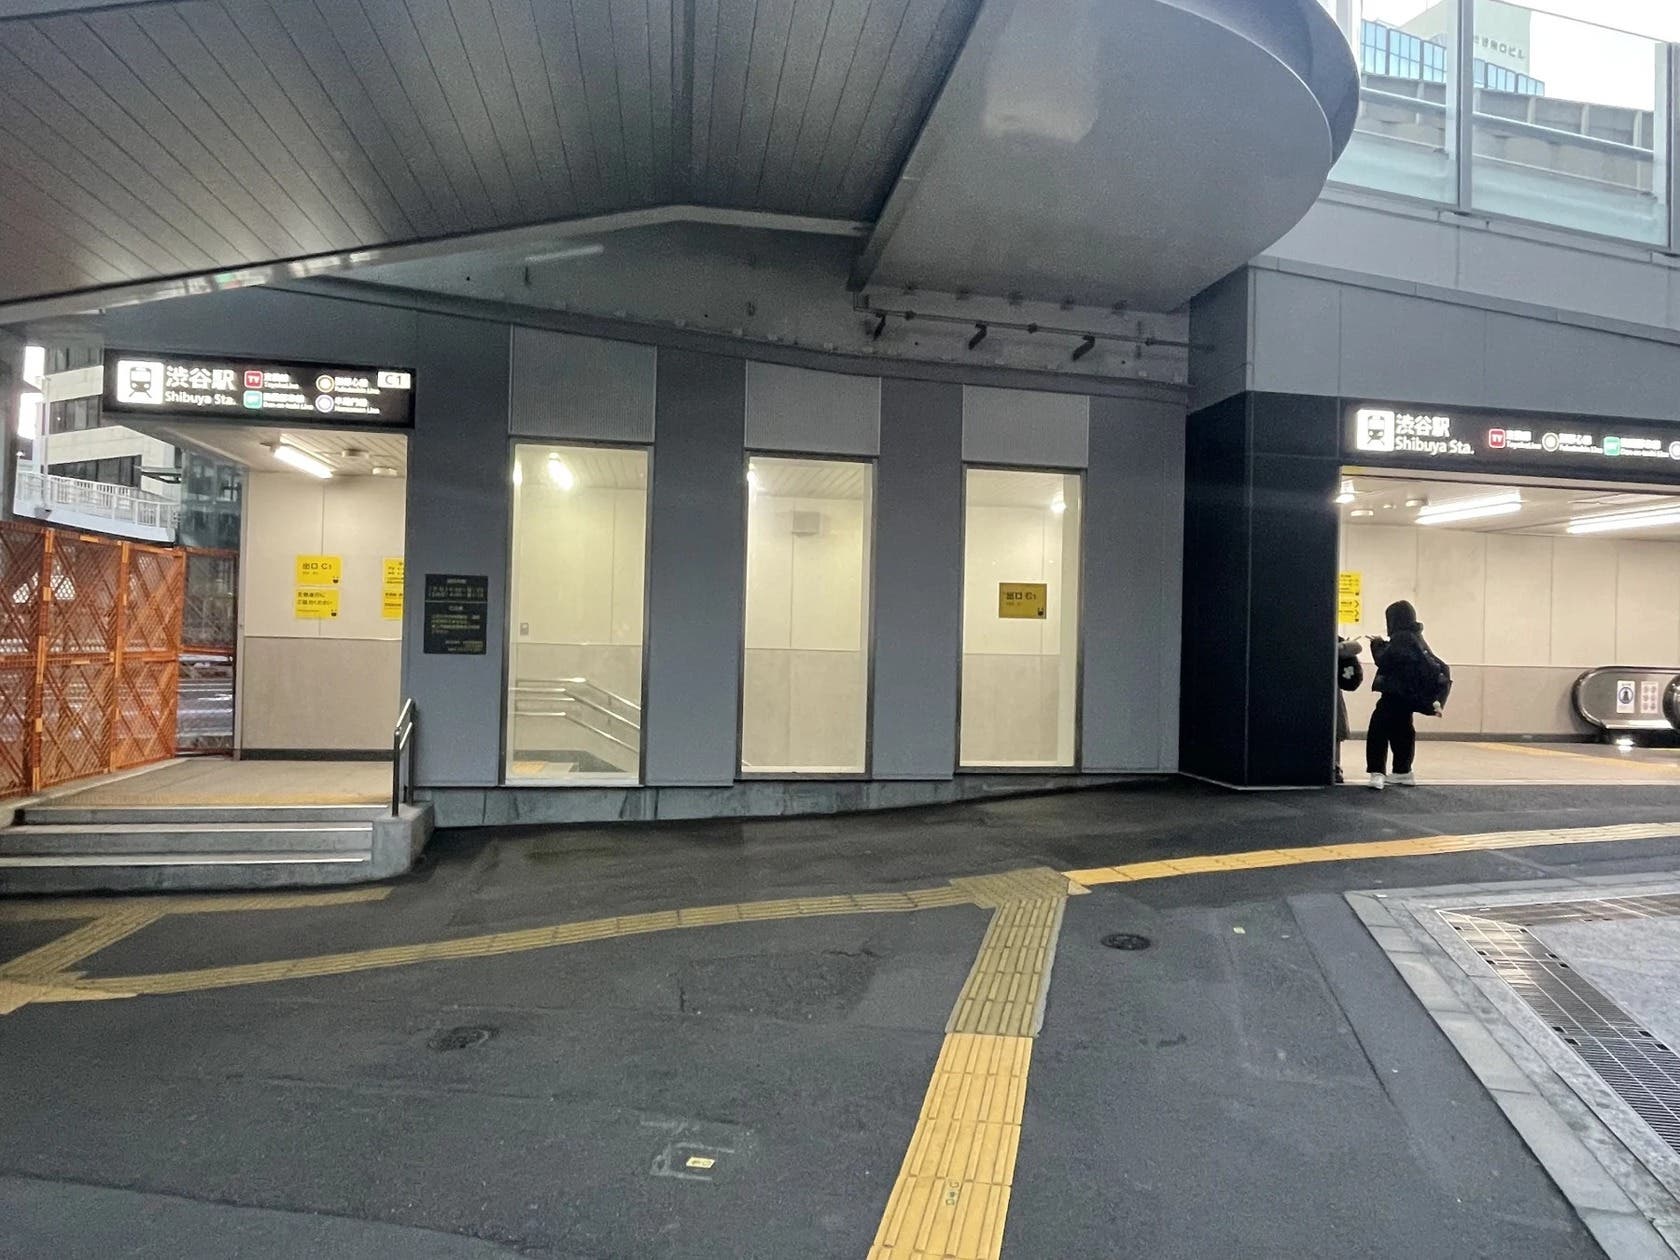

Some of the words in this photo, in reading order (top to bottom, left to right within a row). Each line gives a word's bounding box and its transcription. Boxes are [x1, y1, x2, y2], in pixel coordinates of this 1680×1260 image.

[166, 366, 237, 391] 渋谷駅
[385, 374, 402, 386] C1
[165, 391, 213, 407] Shibuya
[214, 392, 238, 406] Sta.
[1395, 414, 1451, 437] 渋谷駅
[1395, 436, 1448, 455] Shibuya
[1449, 439, 1475, 455] Sta.
